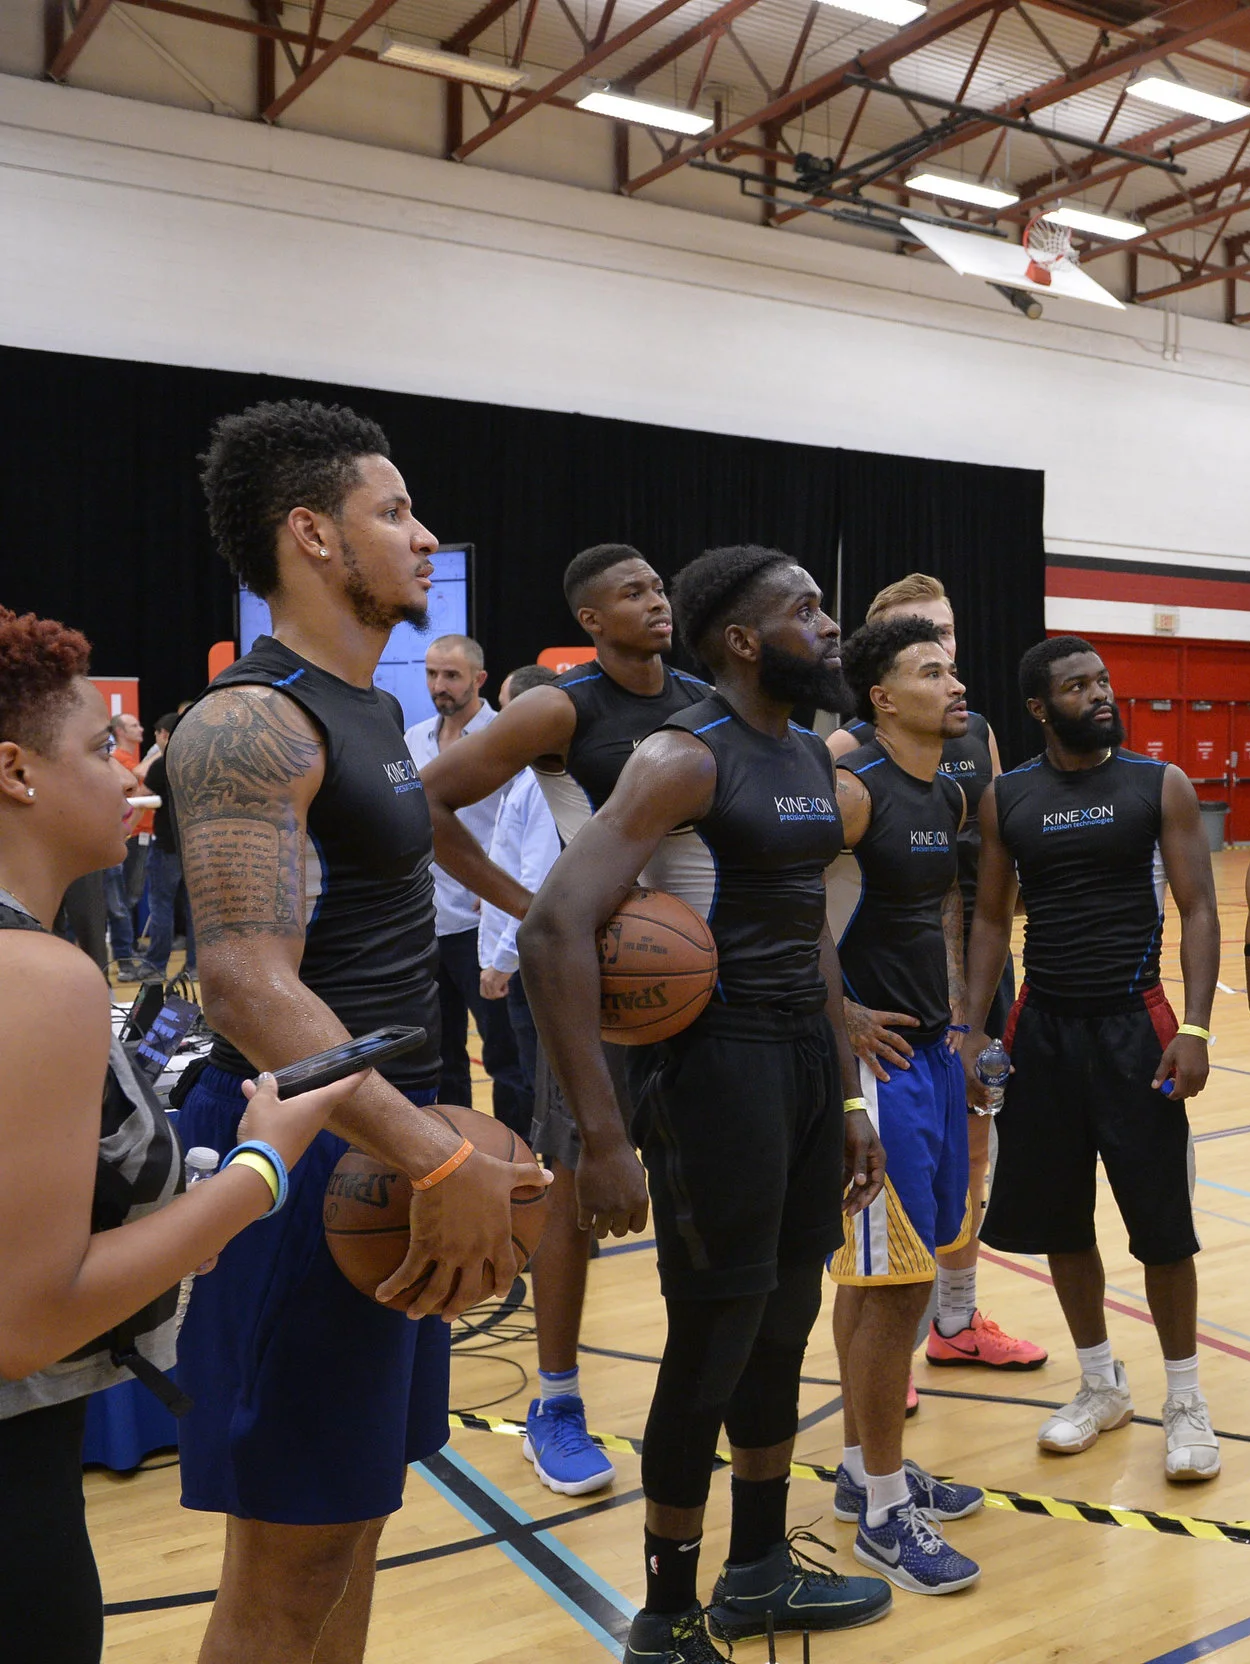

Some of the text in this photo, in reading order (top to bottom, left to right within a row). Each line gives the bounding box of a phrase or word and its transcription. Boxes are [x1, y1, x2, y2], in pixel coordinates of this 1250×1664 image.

[938, 760, 976, 773] NEXON
[774, 797, 833, 813] KINEXON
[780, 814, 805, 822] precision
[1043, 805, 1114, 826] KINEXON
[1043, 817, 1114, 833] precision technologies
[910, 830, 948, 845] KINEXON
